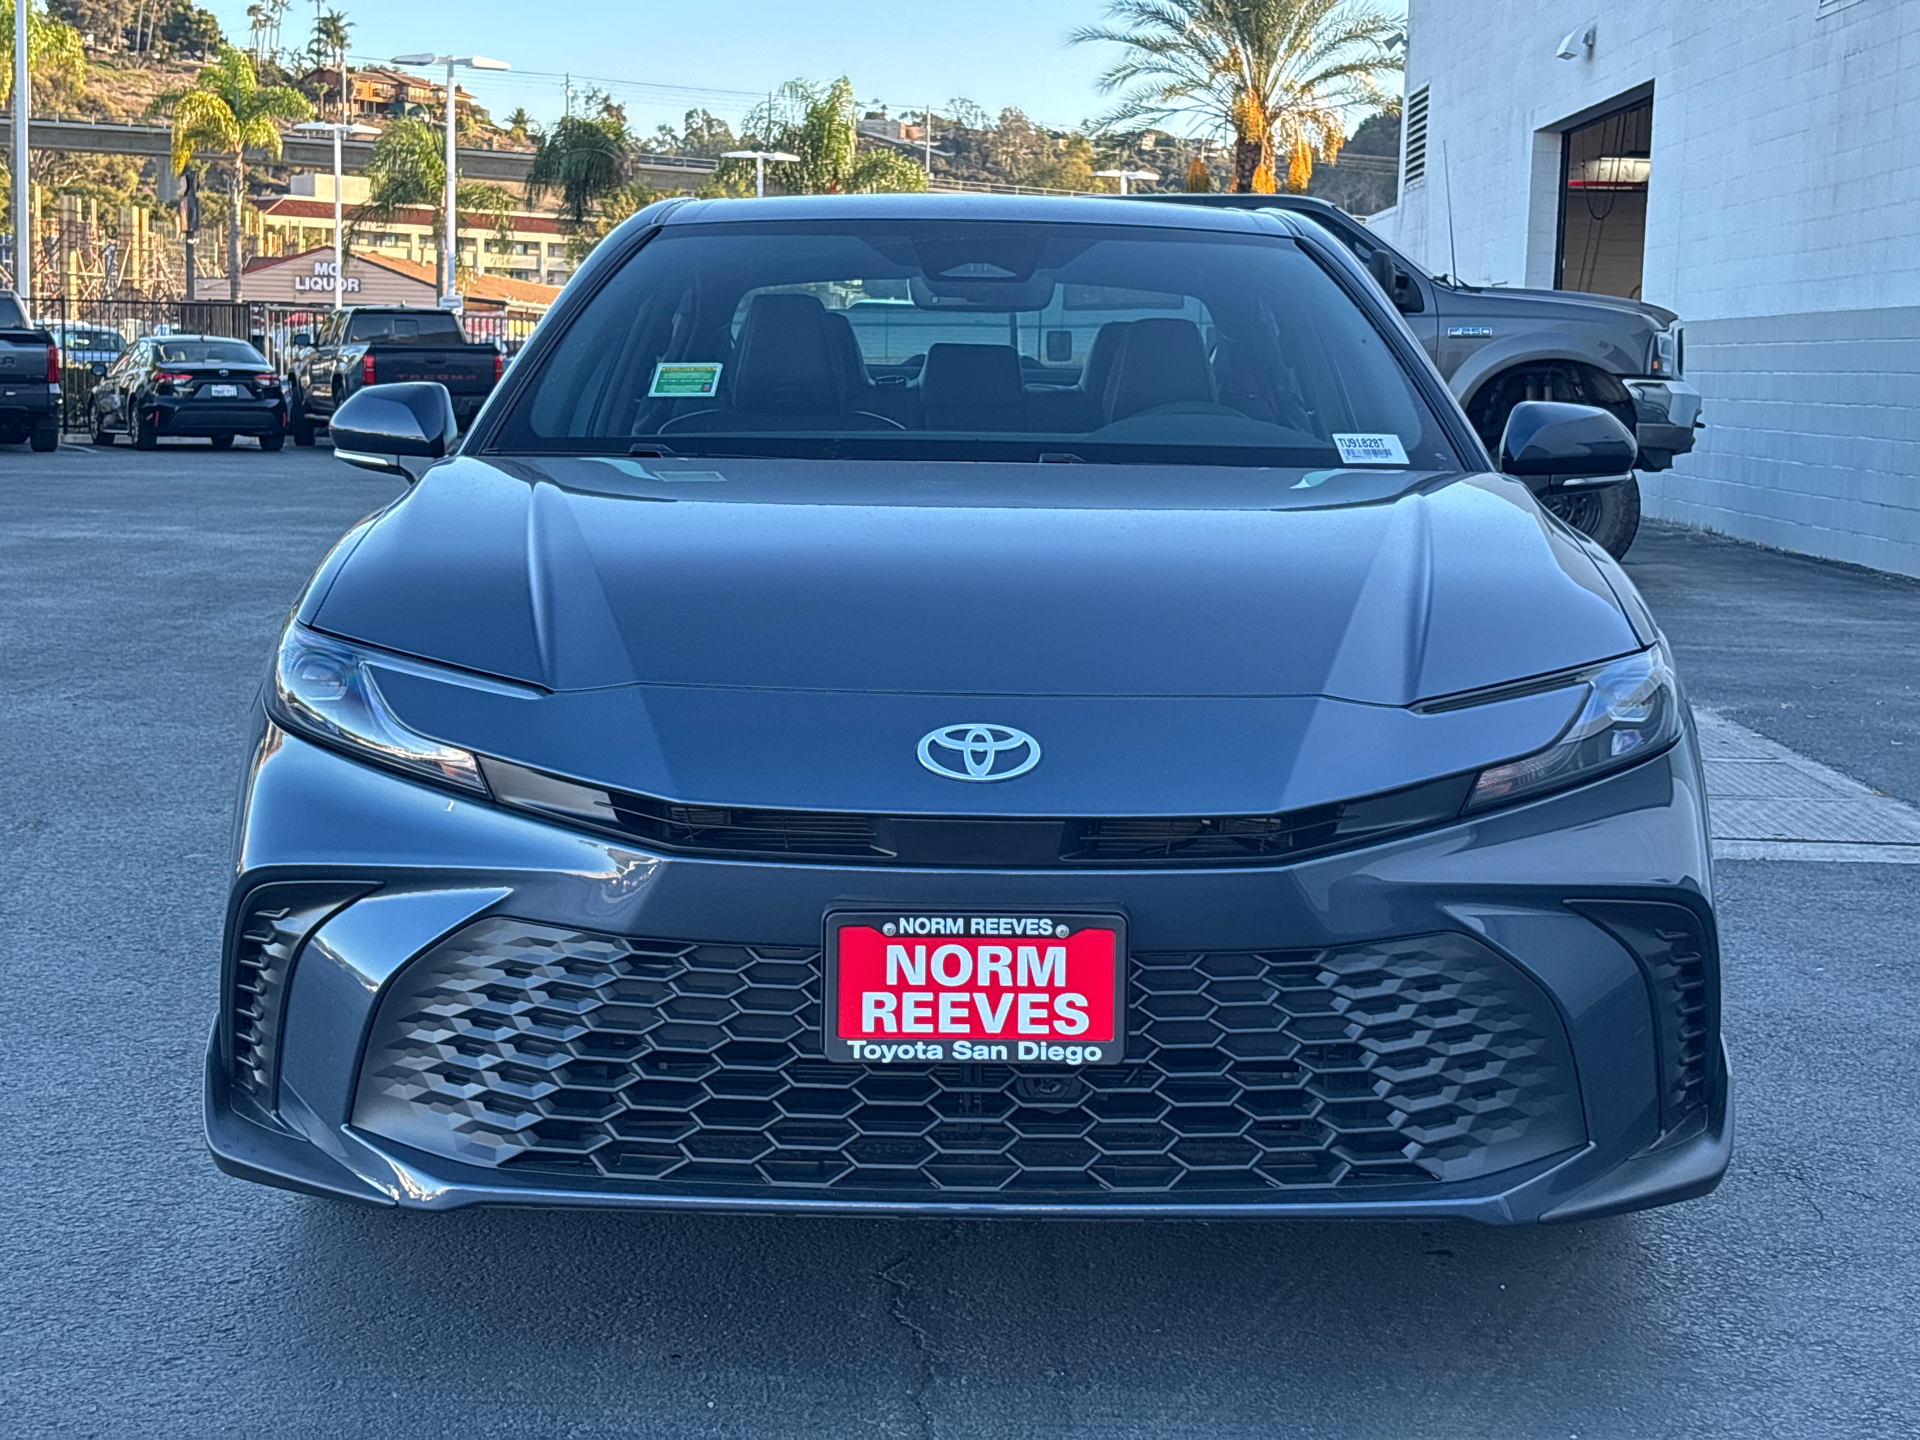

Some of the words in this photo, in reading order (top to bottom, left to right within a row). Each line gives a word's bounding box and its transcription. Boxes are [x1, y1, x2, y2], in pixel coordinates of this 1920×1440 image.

[294, 276, 360, 292] LIQUOR
[1337, 438, 1385, 448] TU91828T
[899, 917, 963, 935] NORM
[970, 918, 1053, 936] REEVES
[886, 944, 1066, 987] NORM
[861, 991, 1089, 1035] REEVES
[847, 1040, 943, 1063] Toyota
[952, 1041, 1007, 1060] San
[1018, 1042, 1102, 1065] Diego
